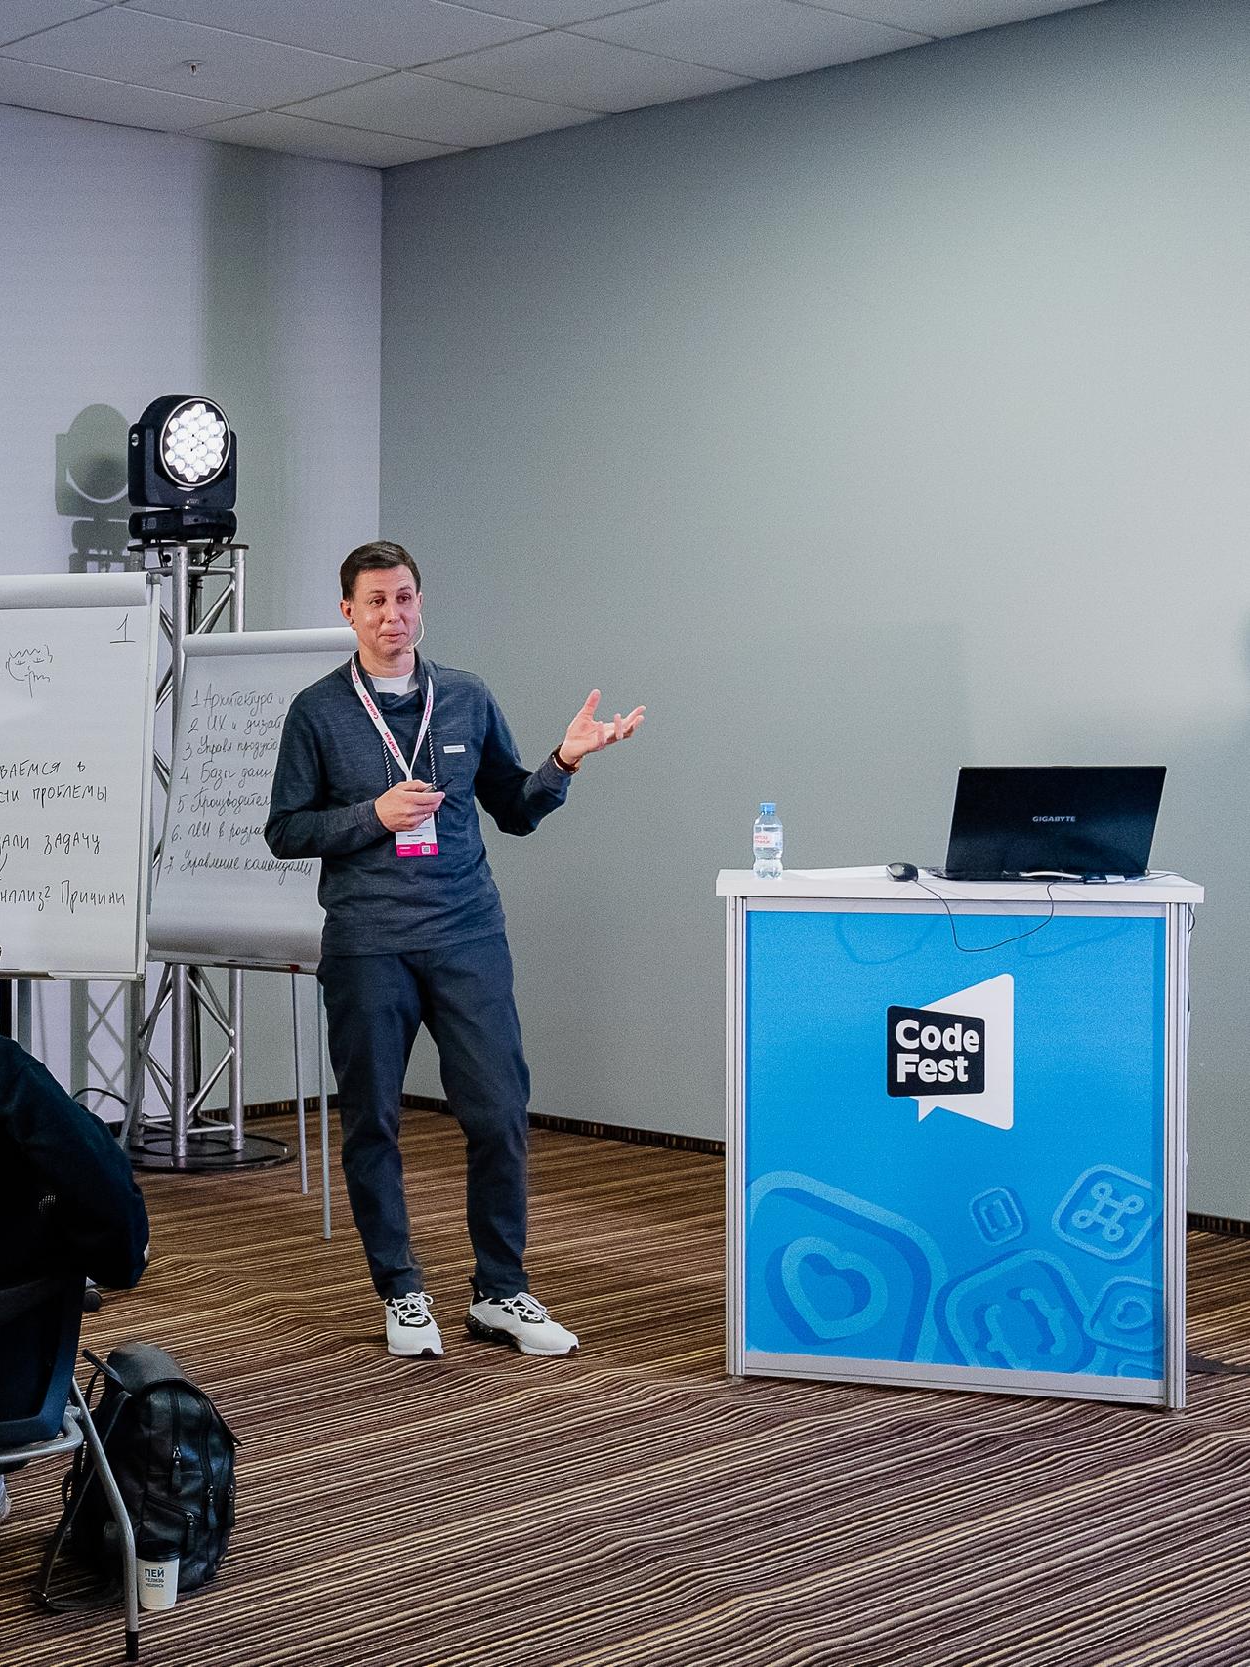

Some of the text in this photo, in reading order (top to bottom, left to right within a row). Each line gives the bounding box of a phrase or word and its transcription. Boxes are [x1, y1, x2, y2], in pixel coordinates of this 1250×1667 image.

[183, 743, 192, 760] 3
[180, 767, 189, 784] 4
[177, 794, 188, 813] 5
[895, 1019, 980, 1053] Code
[896, 1053, 969, 1083] Fest
[144, 1566, 165, 1578] ПЕЙ
